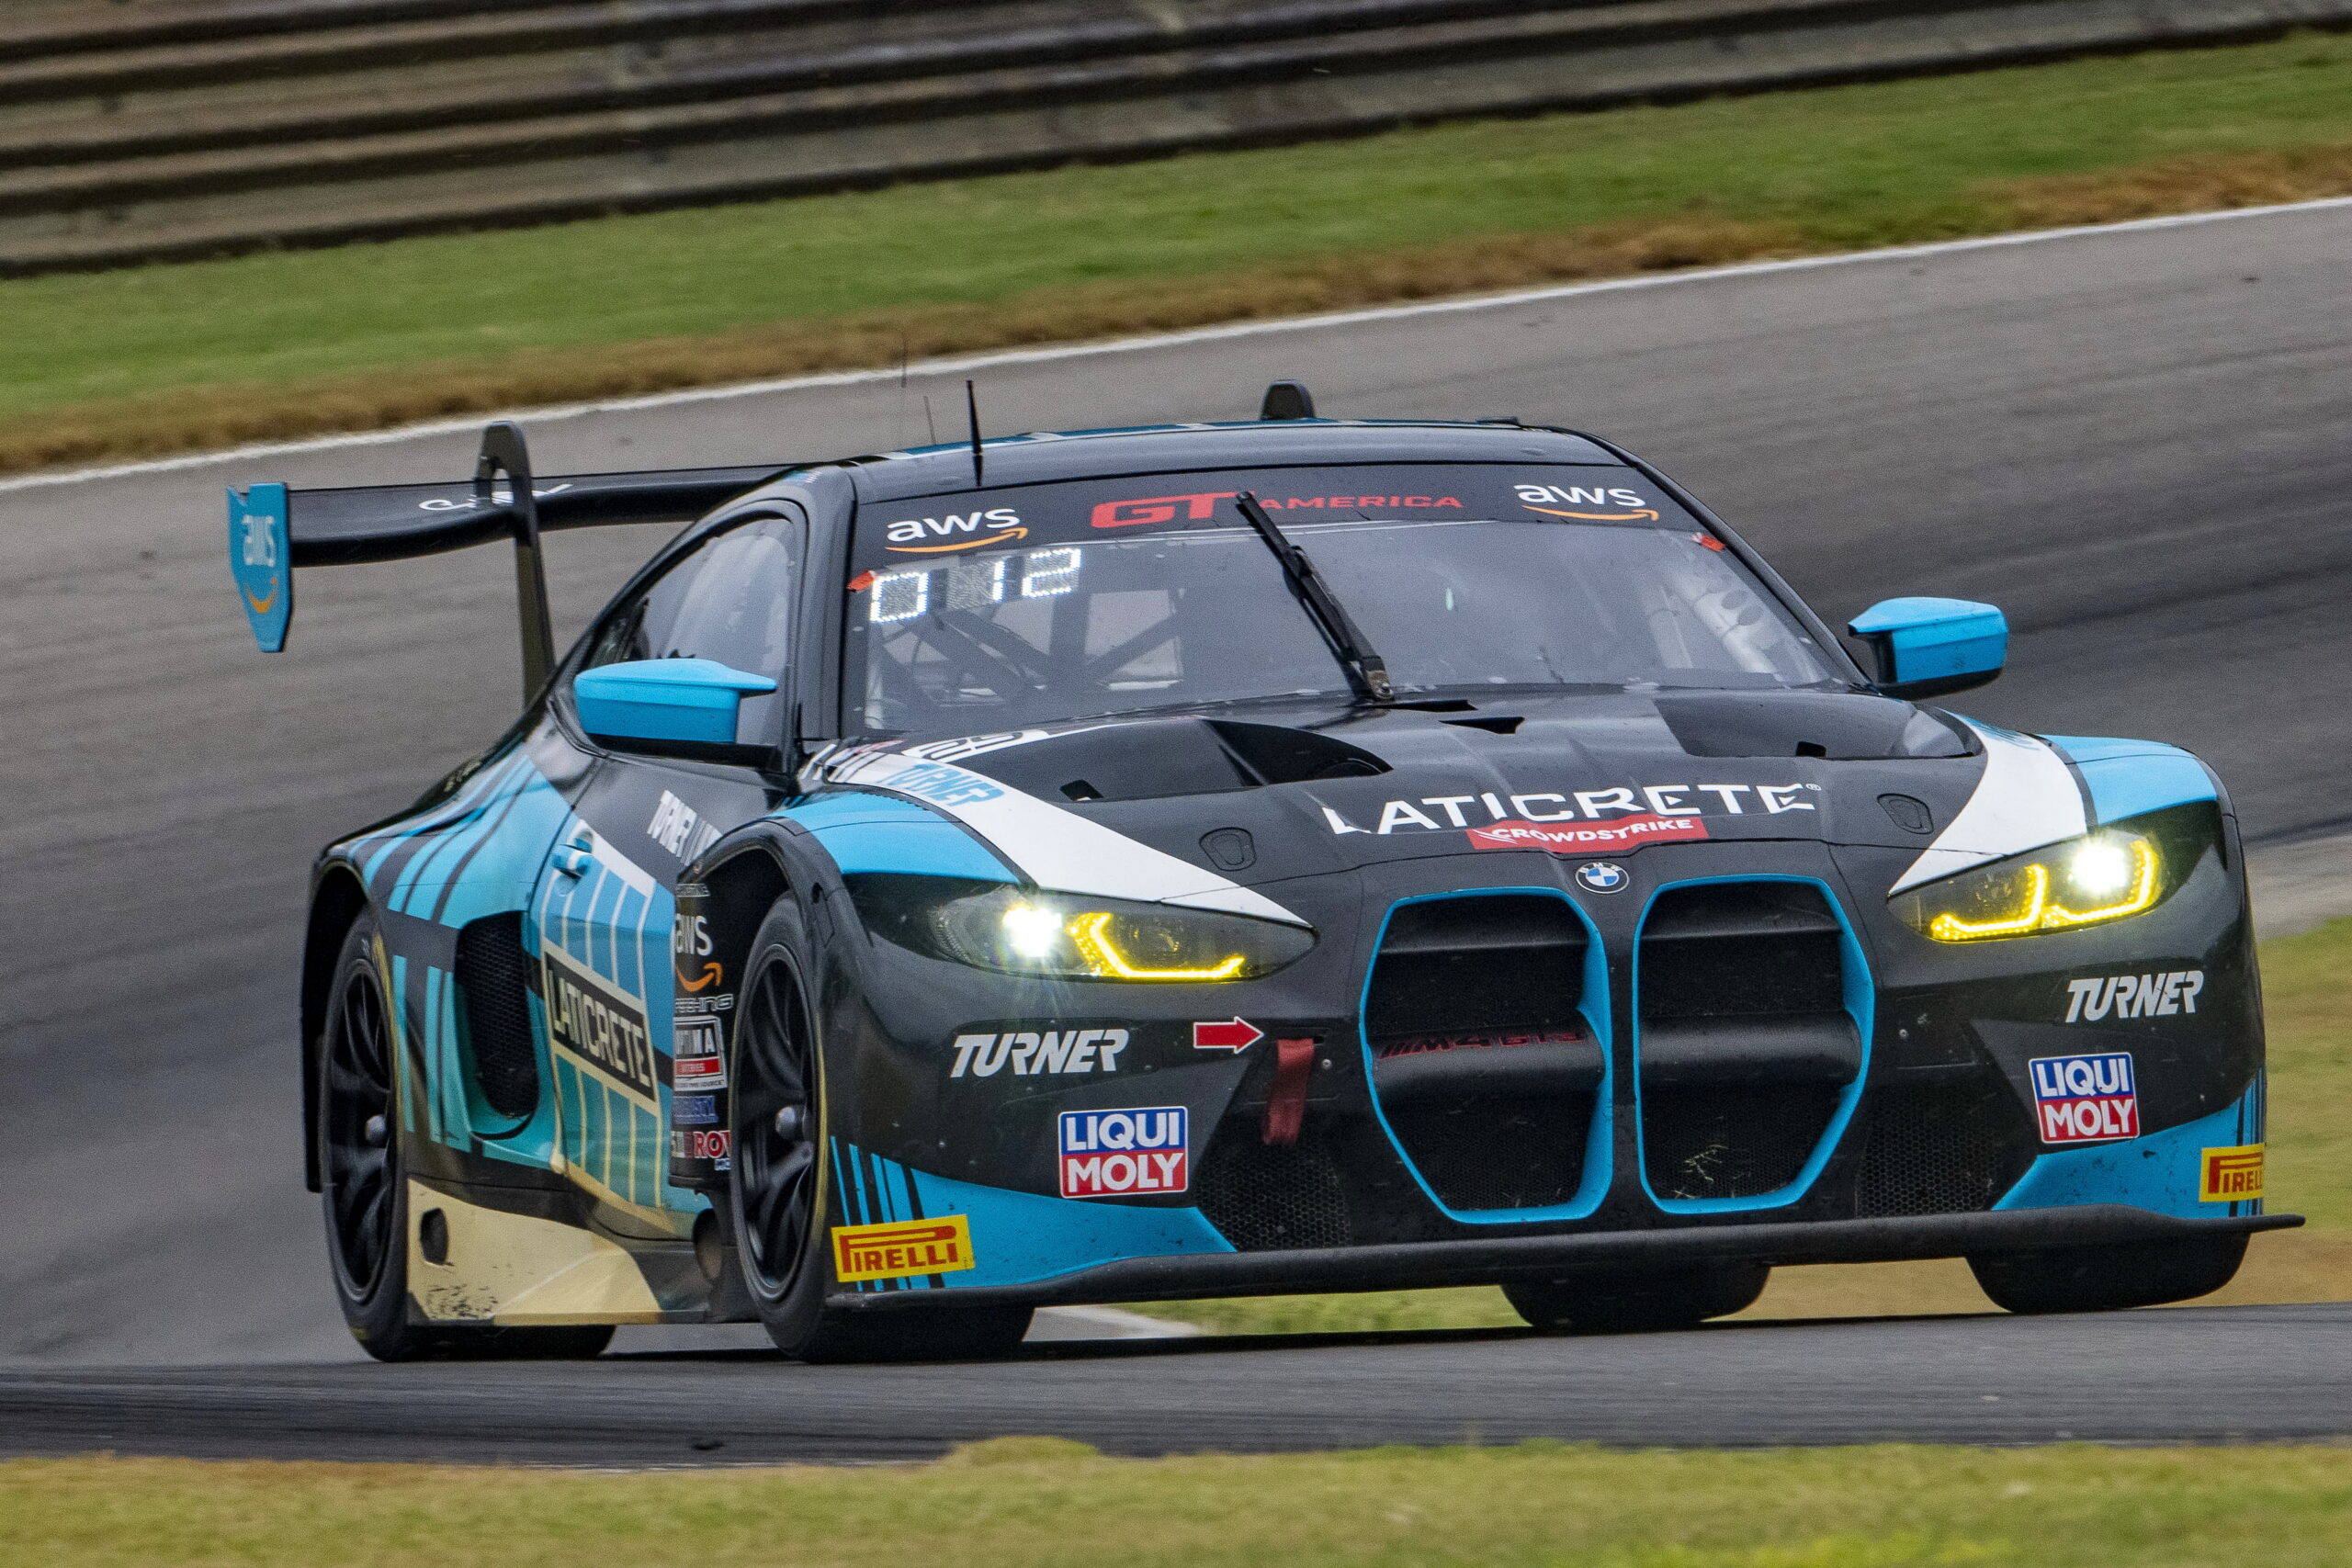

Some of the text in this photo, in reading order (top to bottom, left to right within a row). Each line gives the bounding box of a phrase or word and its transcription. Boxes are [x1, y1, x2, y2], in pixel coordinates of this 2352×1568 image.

[1091, 491, 1465, 528] GT AMERICA
[1514, 483, 1646, 509] aws
[887, 508, 1021, 544] aws
[1322, 783, 1817, 835] LATICRETE
[1490, 818, 1694, 843] CROWDSTRIKE
[2065, 970, 2204, 1023] TURNER
[548, 969, 651, 1088] LATICRETE
[950, 1029, 1129, 1077] TURNER
[2036, 1057, 2131, 1098] LIQUI
[1067, 1111, 1181, 1152] LIQUI
[2043, 1099, 2134, 1138] MOLY
[1067, 1153, 1184, 1193] MOLY
[839, 1225, 959, 1274] PIRELLI
